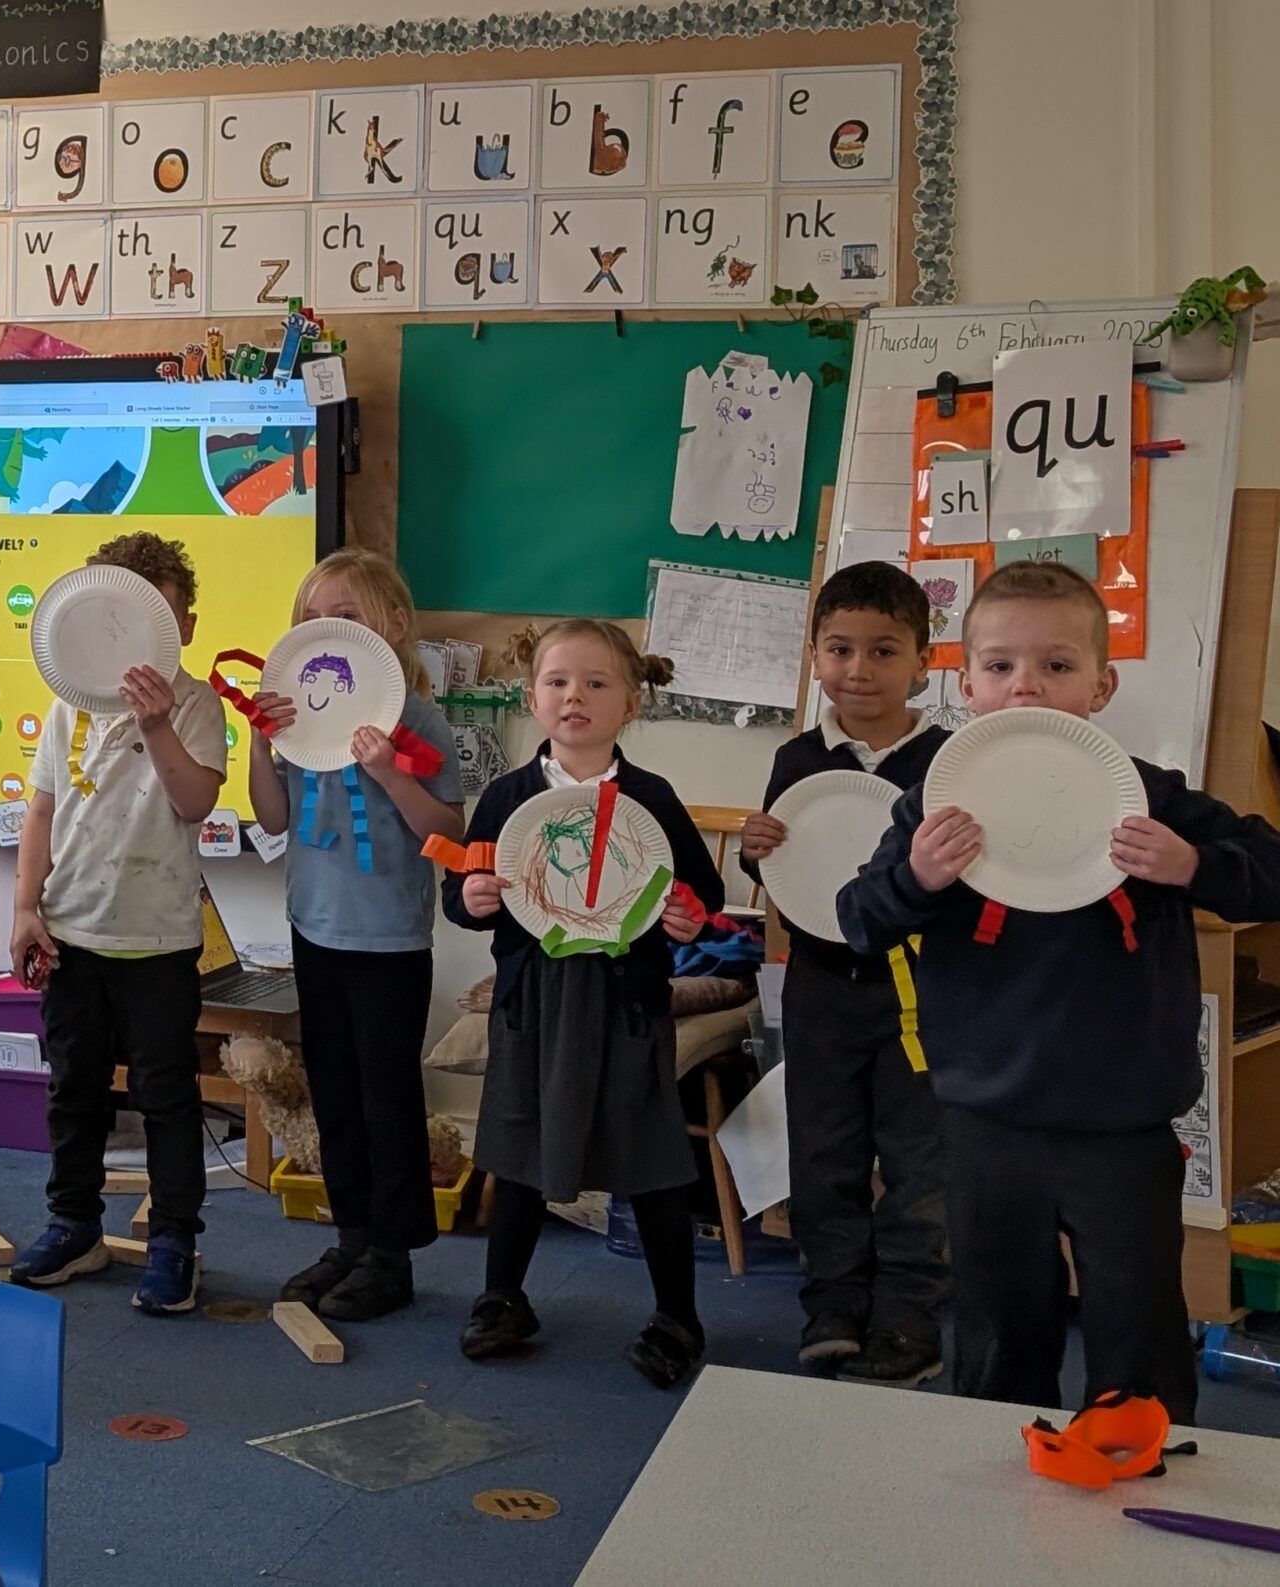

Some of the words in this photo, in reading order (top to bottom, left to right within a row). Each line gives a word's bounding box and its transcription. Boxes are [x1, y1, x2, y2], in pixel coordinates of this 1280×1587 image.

[327, 99, 346, 135] k
[439, 101, 462, 126] u
[550, 88, 571, 126] b
[669, 83, 688, 125] f
[789, 89, 810, 116] e
[22, 126, 41, 161] g
[121, 121, 141, 146] o
[220, 116, 238, 140] c
[220, 225, 237, 249] z
[322, 212, 365, 250] ch
[434, 213, 483, 250] qu
[550, 210, 571, 236] x
[664, 208, 714, 246] ng
[785, 199, 836, 239] nk
[25, 231, 53, 255] w
[117, 221, 152, 257] th
[870, 323, 940, 364] Thursday
[957, 324, 985, 350] 6th
[1005, 394, 1115, 479] qu
[940, 480, 980, 516] sh
[128, 1418, 170, 1435] 13
[493, 1494, 543, 1512] 14
